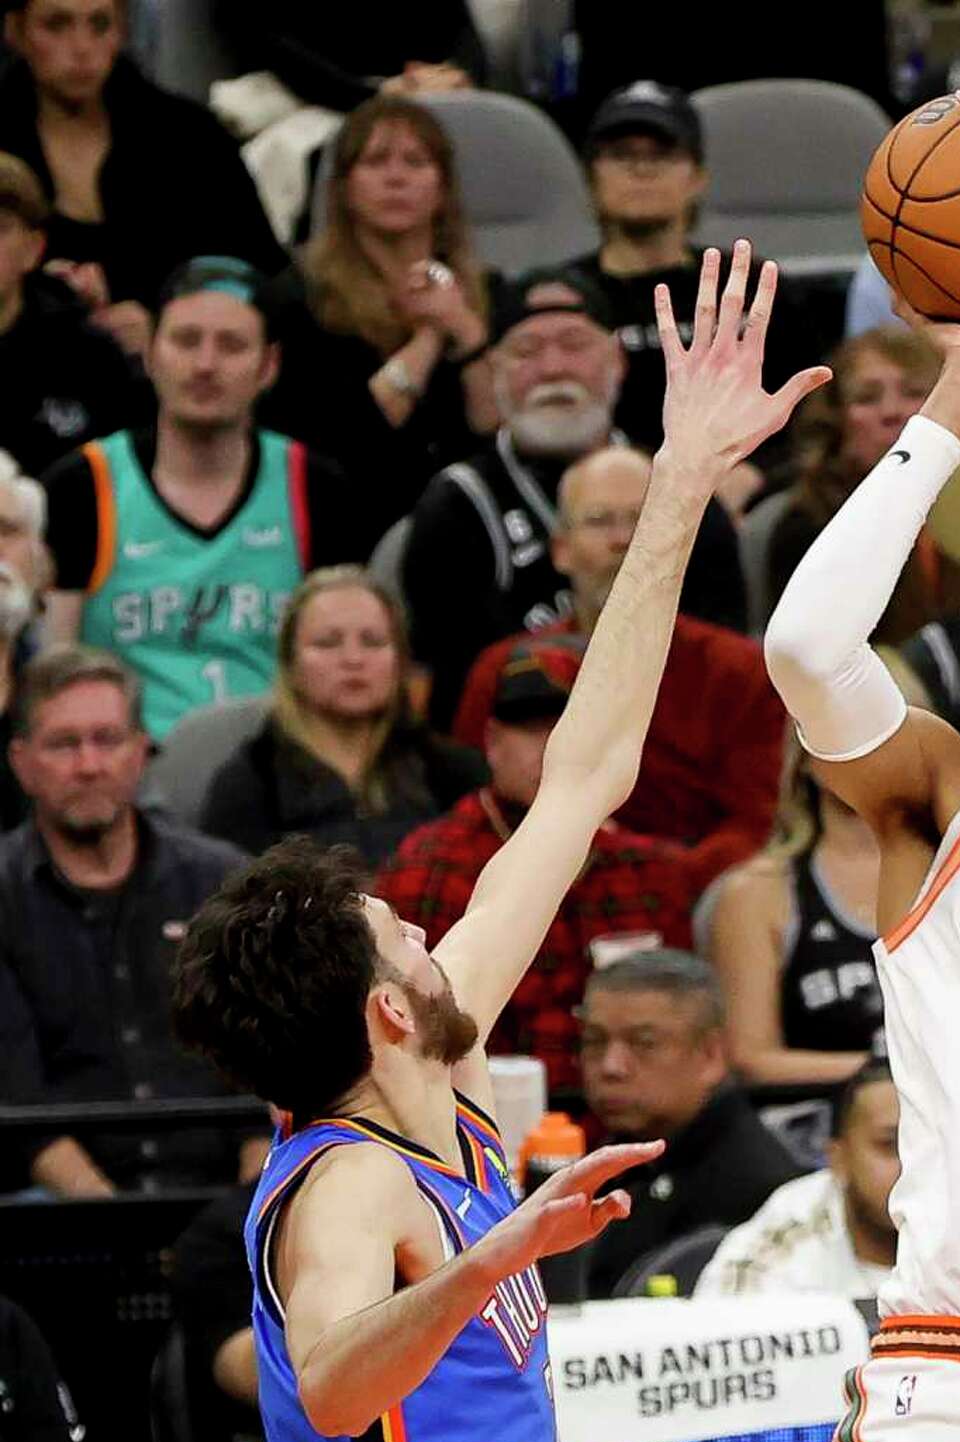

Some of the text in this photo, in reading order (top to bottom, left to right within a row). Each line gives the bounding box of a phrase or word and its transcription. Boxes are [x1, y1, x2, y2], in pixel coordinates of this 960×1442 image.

[564, 1325, 842, 1390] SAN ANTONIO
[638, 1368, 777, 1417] SPURS
